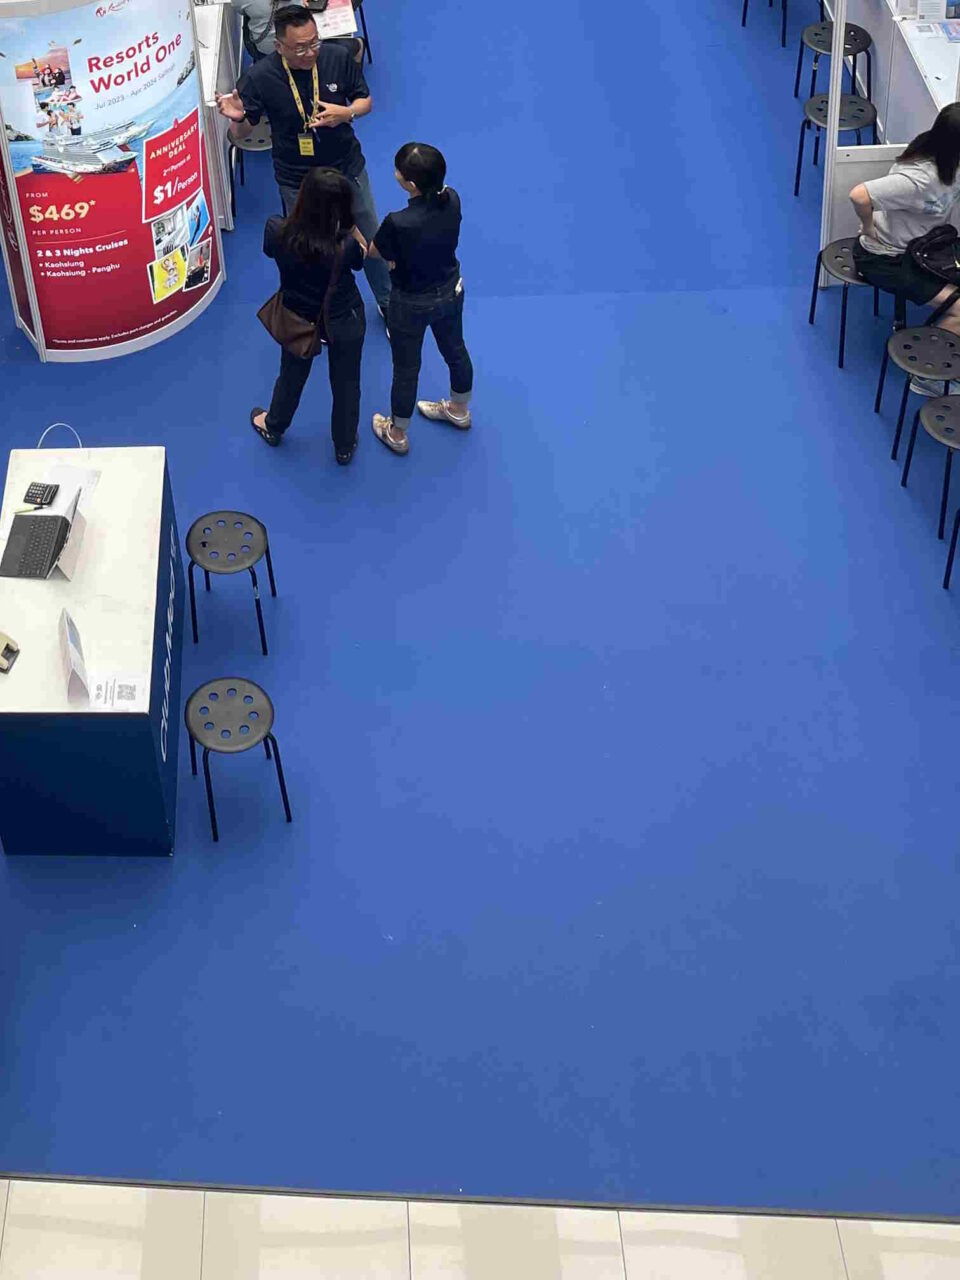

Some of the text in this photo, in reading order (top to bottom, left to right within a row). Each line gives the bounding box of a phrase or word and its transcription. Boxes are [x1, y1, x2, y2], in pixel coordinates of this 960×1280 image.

[87, 32, 159, 73] Resorts
[90, 33, 182, 94] World One
[95, 100, 106, 110] Jul
[108, 94, 125, 107] 2023
[150, 124, 198, 159] ANNIVERSARY
[169, 145, 186, 158] DEAL
[63, 246, 93, 259] Nights
[96, 239, 129, 252] Cruises
[45, 260, 84, 270] Kaohsiung
[46, 263, 120, 278] Kaohsiung Penghu
